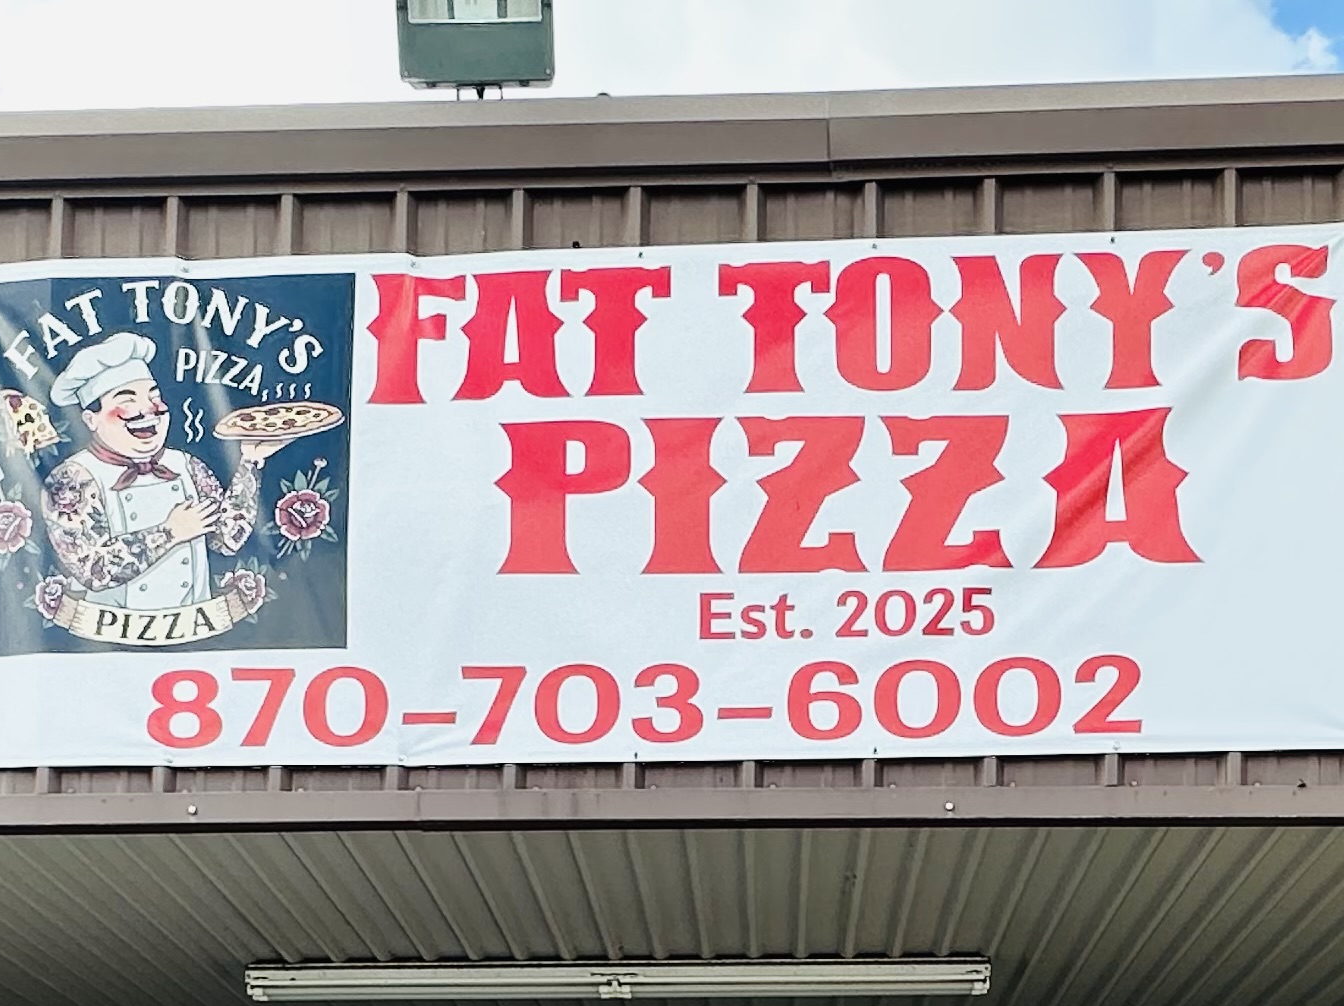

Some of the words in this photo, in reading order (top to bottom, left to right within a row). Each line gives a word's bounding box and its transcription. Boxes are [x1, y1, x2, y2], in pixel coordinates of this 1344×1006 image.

[3, 287, 103, 380] FAT
[121, 280, 323, 374] TONY'S
[176, 346, 264, 396] PIZZA
[368, 267, 671, 404] FAT
[719, 245, 1333, 392] TONY'S
[496, 408, 1198, 573] PIZZA
[94, 606, 216, 641] PIZZA
[699, 592, 814, 640] Est.
[837, 587, 995, 638] 2025
[146, 654, 1142, 748] 870-703-6002
